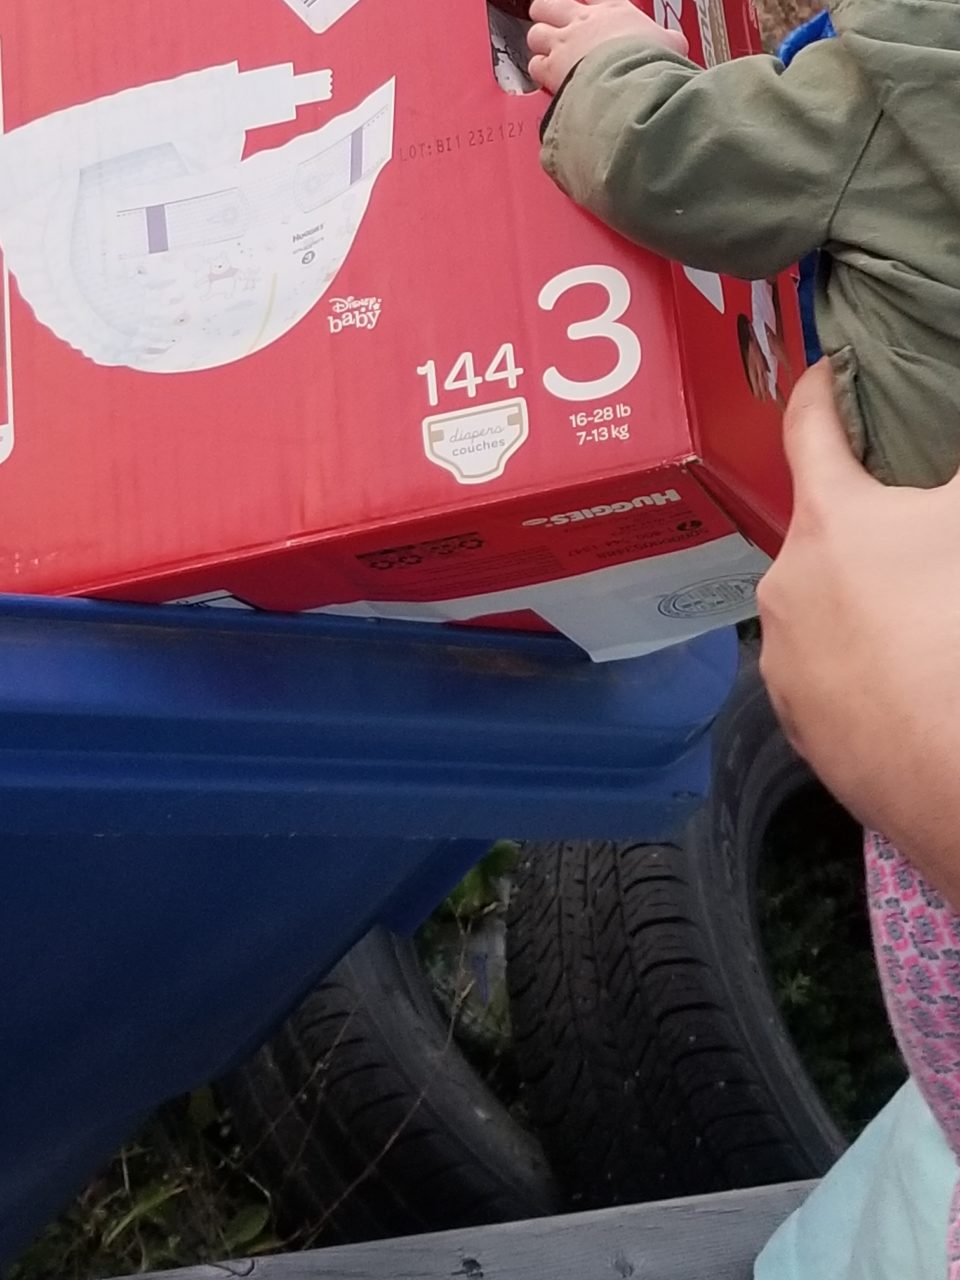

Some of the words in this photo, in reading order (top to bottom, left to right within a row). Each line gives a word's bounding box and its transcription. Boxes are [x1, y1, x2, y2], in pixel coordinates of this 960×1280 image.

[327, 308, 382, 334] baby
[537, 264, 642, 402] 3
[417, 343, 524, 406] 144
[569, 406, 614, 428] 16-28
[616, 404, 632, 418] lb
[449, 424, 506, 443] diapers
[576, 426, 609, 446] 7-13
[611, 423, 630, 441] kg
[452, 437, 506, 457] couches
